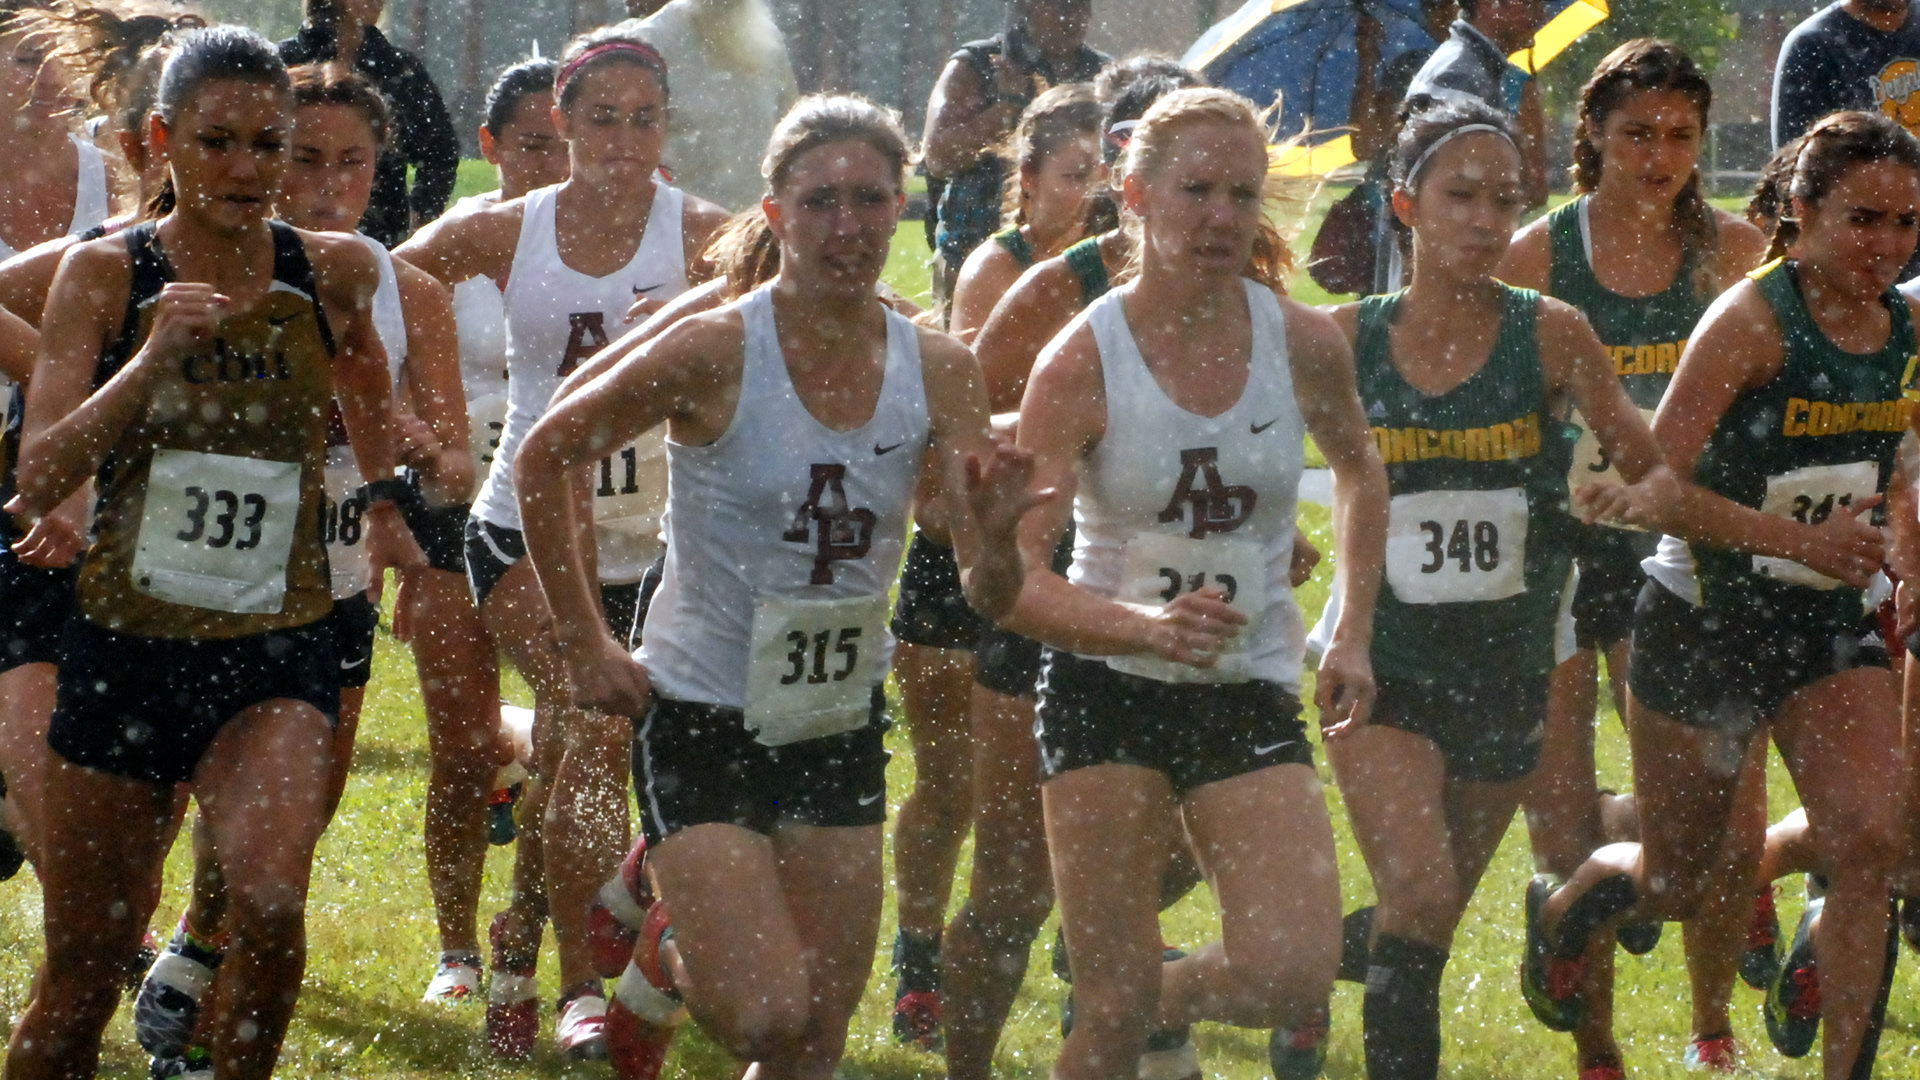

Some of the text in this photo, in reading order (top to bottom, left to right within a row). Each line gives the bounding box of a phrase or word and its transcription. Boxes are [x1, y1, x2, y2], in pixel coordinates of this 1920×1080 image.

[557, 311, 610, 377] A
[596, 447, 639, 498] 11
[1158, 446, 1257, 540] AP
[177, 486, 266, 551] 333
[783, 463, 876, 585] AP
[1420, 519, 1500, 574] 348
[780, 627, 862, 685] 315
